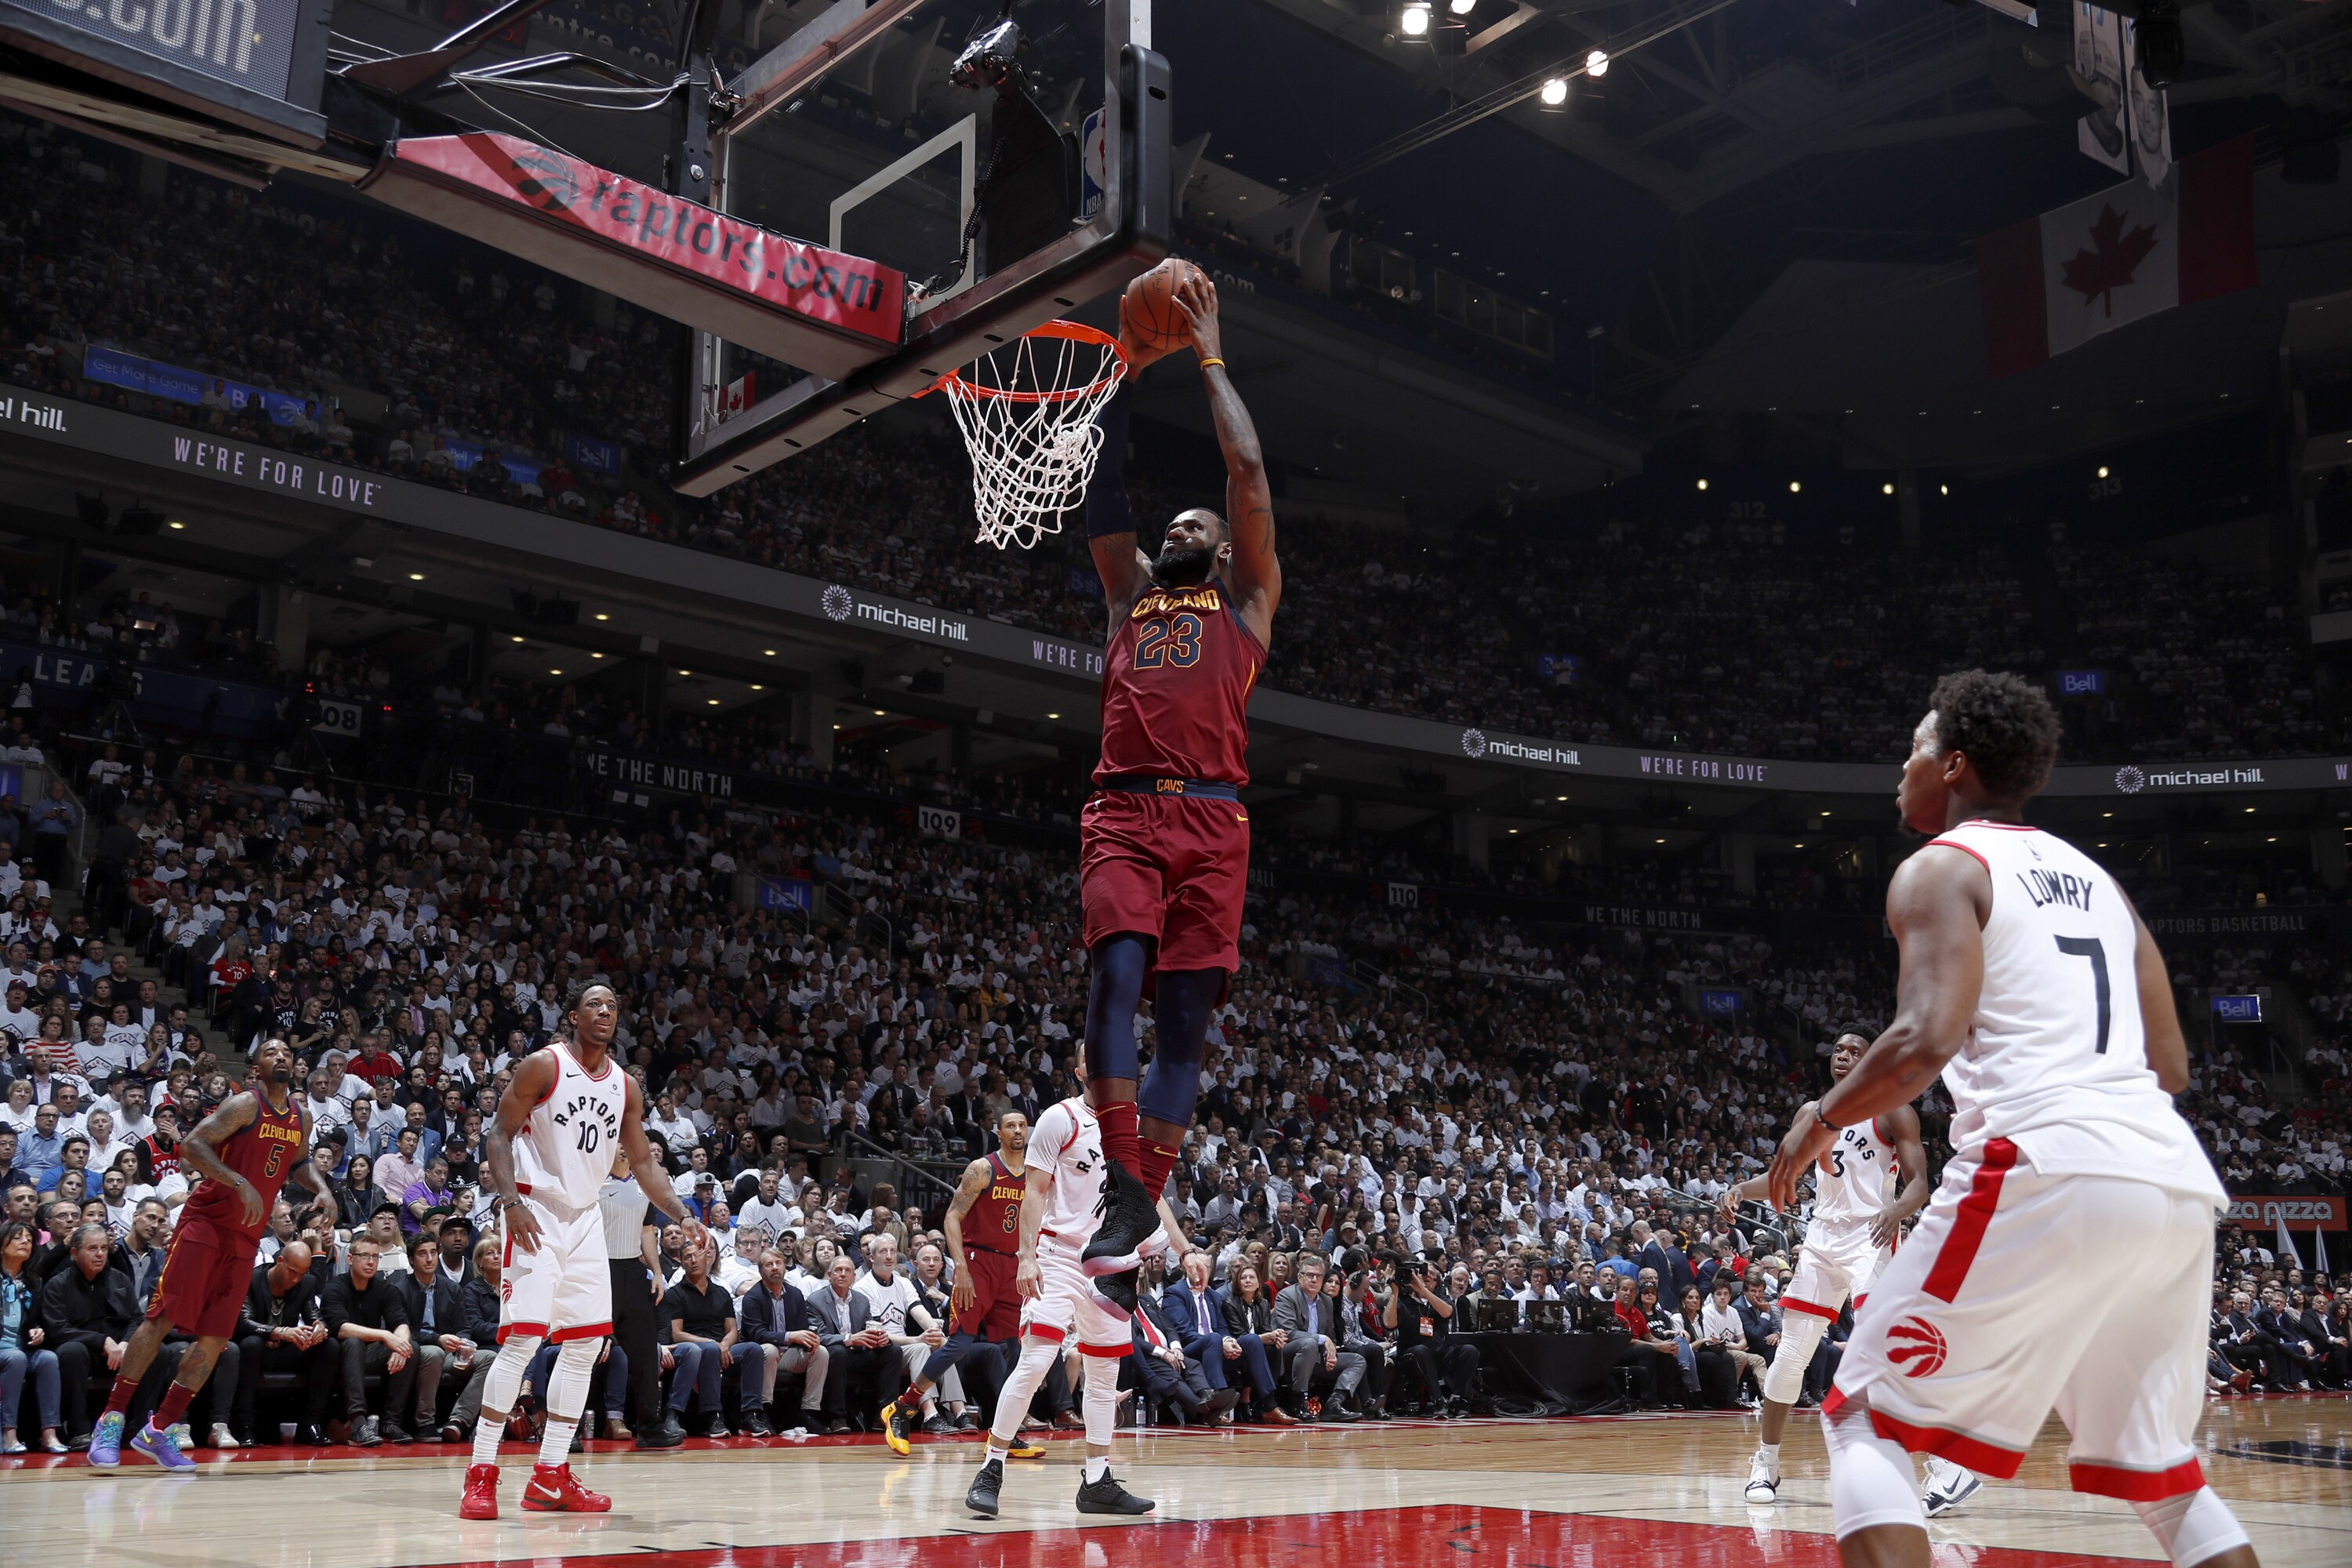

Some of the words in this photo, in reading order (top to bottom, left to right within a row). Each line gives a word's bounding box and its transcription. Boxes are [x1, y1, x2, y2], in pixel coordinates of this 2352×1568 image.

[49, 0, 257, 74] .com
[1086, 192, 1102, 216] NBA
[598, 178, 885, 313] raptors.com
[94, 358, 118, 376] Get
[122, 366, 157, 383] More
[159, 376, 198, 394] Game
[20, 401, 67, 432] hill.
[174, 436, 245, 475] WE'RE
[260, 456, 303, 490] FOR
[451, 448, 468, 462] Bell
[2089, 477, 2122, 499] 313
[1730, 502, 1766, 519] 312
[858, 602, 935, 633] michael
[940, 619, 969, 641] hill.
[1033, 640, 1076, 668] WE'RE
[1134, 613, 1203, 670] 23
[2065, 673, 2096, 691] Bell
[322, 706, 357, 730] 08
[1490, 741, 1552, 762] michael
[1555, 749, 1581, 765] hill.
[616, 757, 655, 784] THE
[663, 766, 732, 797] NORTH
[1641, 757, 1683, 775] WE'RE
[1693, 760, 1719, 778] FOR
[2150, 769, 2229, 786] michael
[2234, 768, 2264, 783] hill.
[1156, 779, 1184, 793] CAVS
[921, 811, 956, 833] 109
[769, 881, 802, 908] Bell
[1391, 887, 1416, 904] 110
[2016, 869, 2092, 912] LOWRY
[1585, 906, 1605, 923] WE
[1610, 908, 1641, 925] THE
[1646, 909, 1700, 928] NORTH
[2148, 918, 2205, 934] APTORS
[2212, 916, 2306, 933] BASKETBALL
[233, 971, 243, 980] 10
[2053, 934, 2111, 1054] 7
[2220, 1000, 2250, 1017] Bell
[283, 1017, 292, 1027] 10
[554, 1095, 617, 1139] RAPTORS
[259, 1123, 301, 1147] CLEVELAND
[577, 1120, 598, 1153] 10
[1844, 1129, 1875, 1160] ORS
[264, 1143, 286, 1178] 5
[1831, 1150, 1846, 1178] 3
[1003, 1203, 1019, 1234] 3
[2263, 1201, 2332, 1226] pizza
